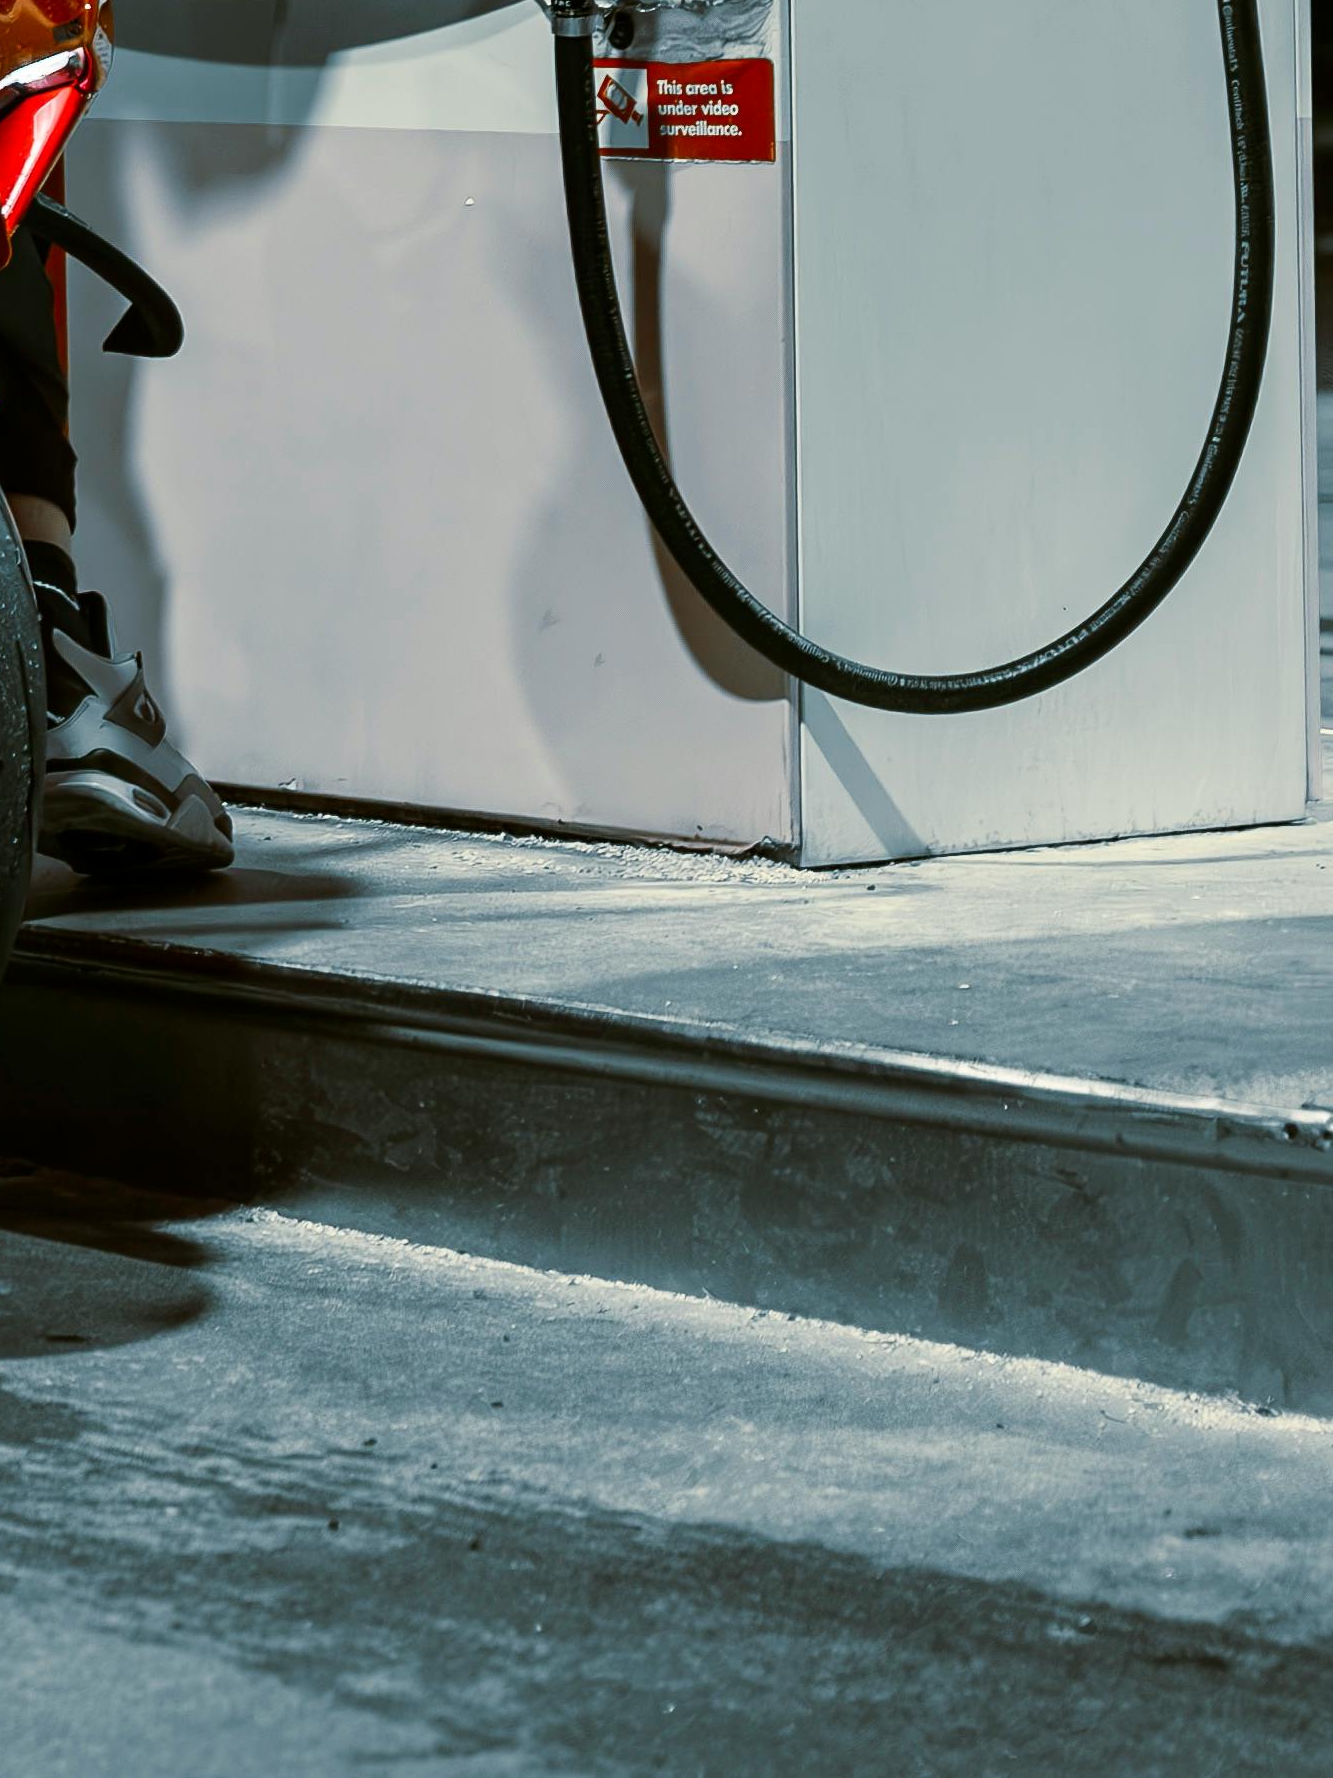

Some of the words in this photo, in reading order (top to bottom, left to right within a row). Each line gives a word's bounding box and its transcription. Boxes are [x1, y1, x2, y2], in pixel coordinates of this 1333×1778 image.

[657, 79, 683, 95] This
[685, 82, 717, 95] area
[720, 79, 734, 95] is
[657, 99, 698, 116] under
[700, 99, 739, 116] video
[660, 120, 743, 137] surveillance.
